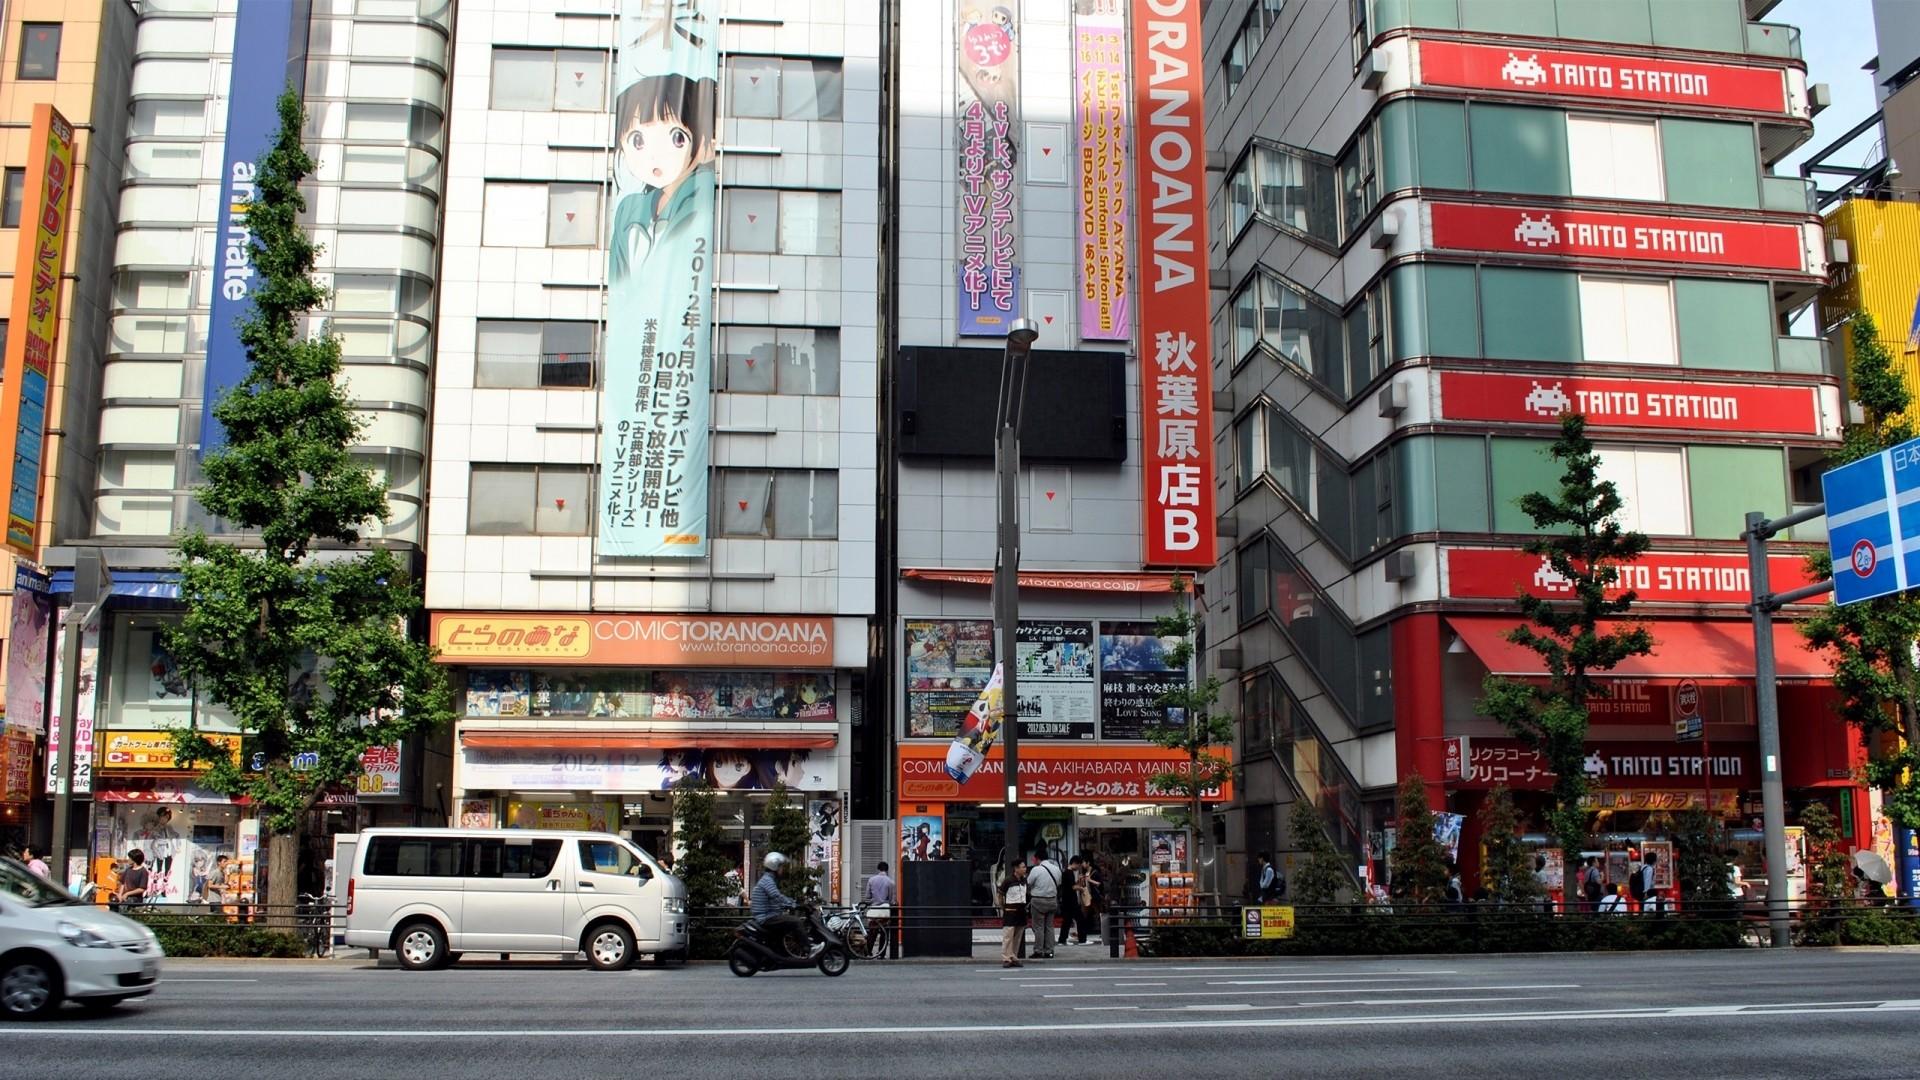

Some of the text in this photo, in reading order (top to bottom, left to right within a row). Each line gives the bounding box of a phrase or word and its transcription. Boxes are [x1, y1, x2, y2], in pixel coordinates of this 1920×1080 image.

[1550, 62, 1708, 96] TAITO STATION
[1564, 222, 1724, 254] TAITO STATION
[1575, 391, 1738, 420] TAITO STATION
[1155, 331, 1200, 551] 秋葉原店B
[16, 572, 49, 593] animate
[1658, 566, 1750, 592] STATION
[448, 624, 581, 646] とらのあな
[679, 642, 827, 655] www.toranoana.co.jp/
[1053, 761, 1133, 774] AKIHABARA
[1137, 762, 1174, 774] MAIN
[1611, 756, 1742, 776] TAITO STATION
[359, 774, 383, 793] 6.8
[1024, 780, 1140, 797] コミックとらのあな
